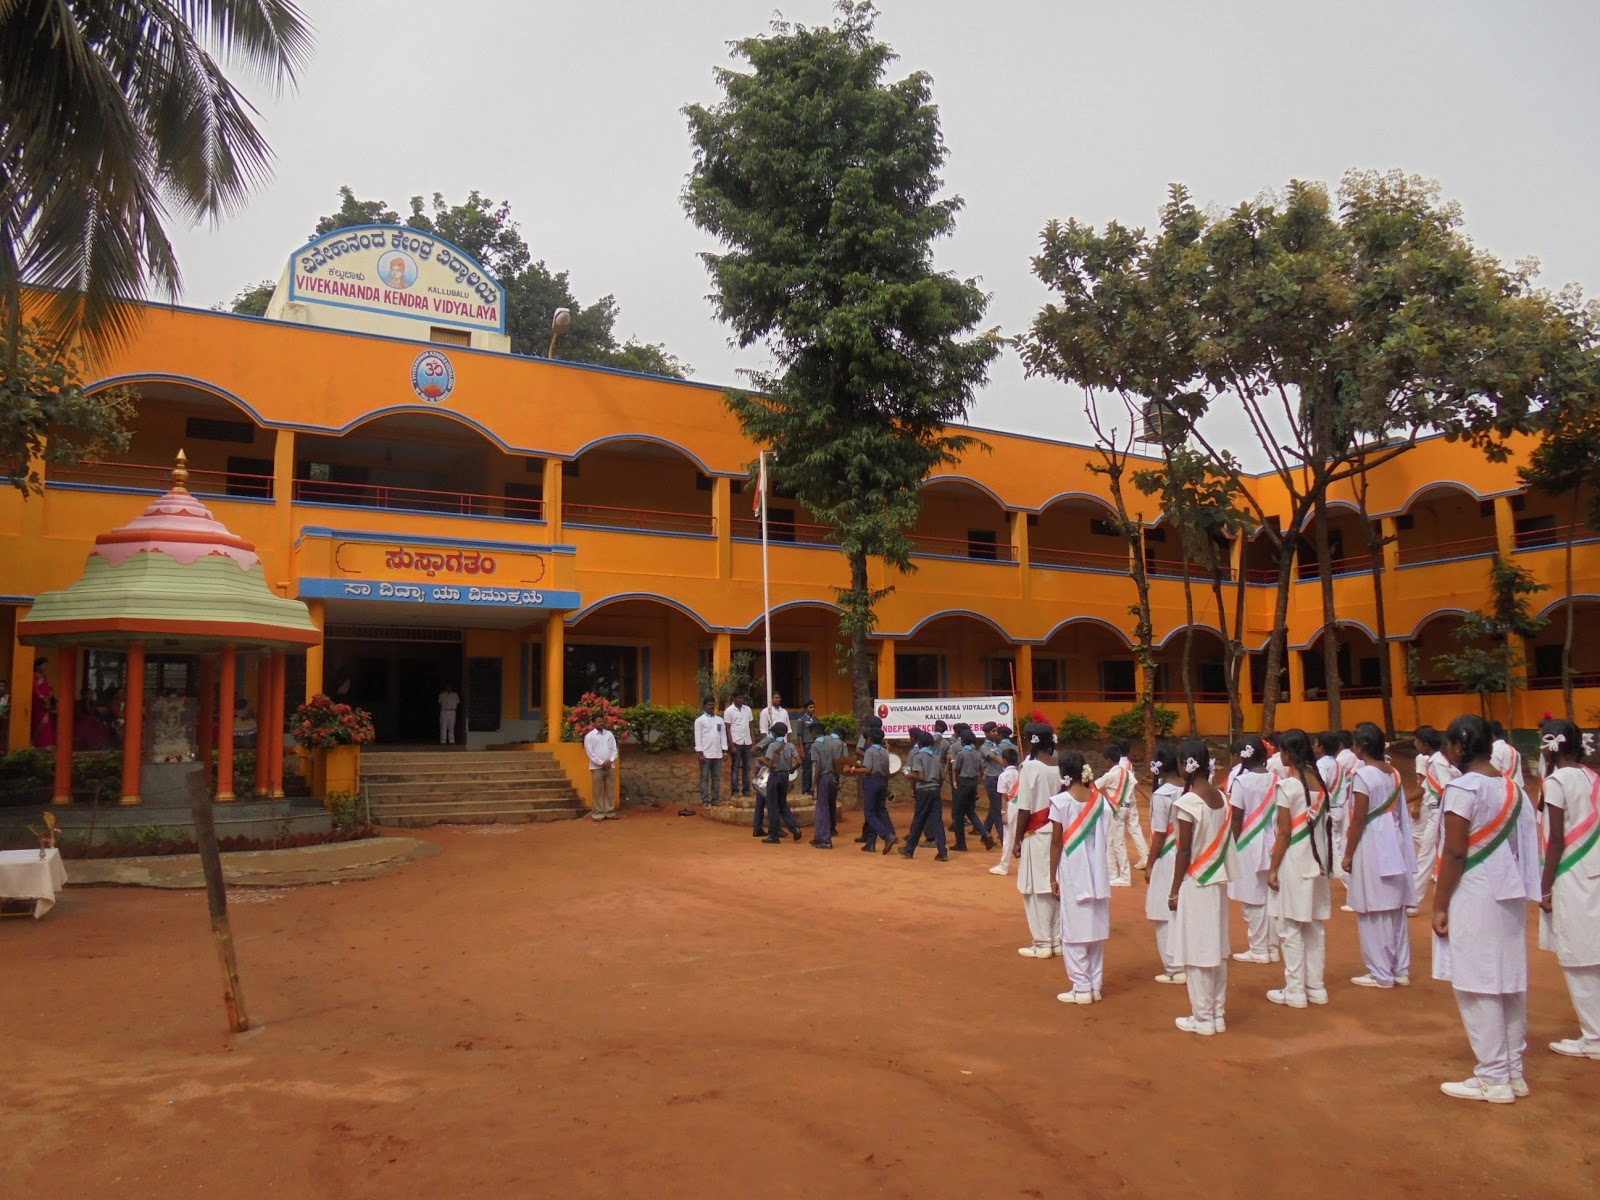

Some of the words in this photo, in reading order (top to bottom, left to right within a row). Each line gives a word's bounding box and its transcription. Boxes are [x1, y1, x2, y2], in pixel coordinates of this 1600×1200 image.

[436, 249, 498, 306] ವಿದ್ಯಾಲಯ
[296, 274, 380, 302] VIVEKANANDA
[384, 289, 429, 311] KENDRA
[433, 298, 497, 322] VIDYALAYA
[427, 286, 470, 299] KALLUBALU
[344, 582, 372, 596] ಸಾ
[379, 582, 426, 603] ವಿದ್ಯಾ
[432, 586, 461, 600] ಯಾ
[890, 704, 933, 712] VIVEKANANDA
[962, 703, 996, 711] VIDYALAYA
